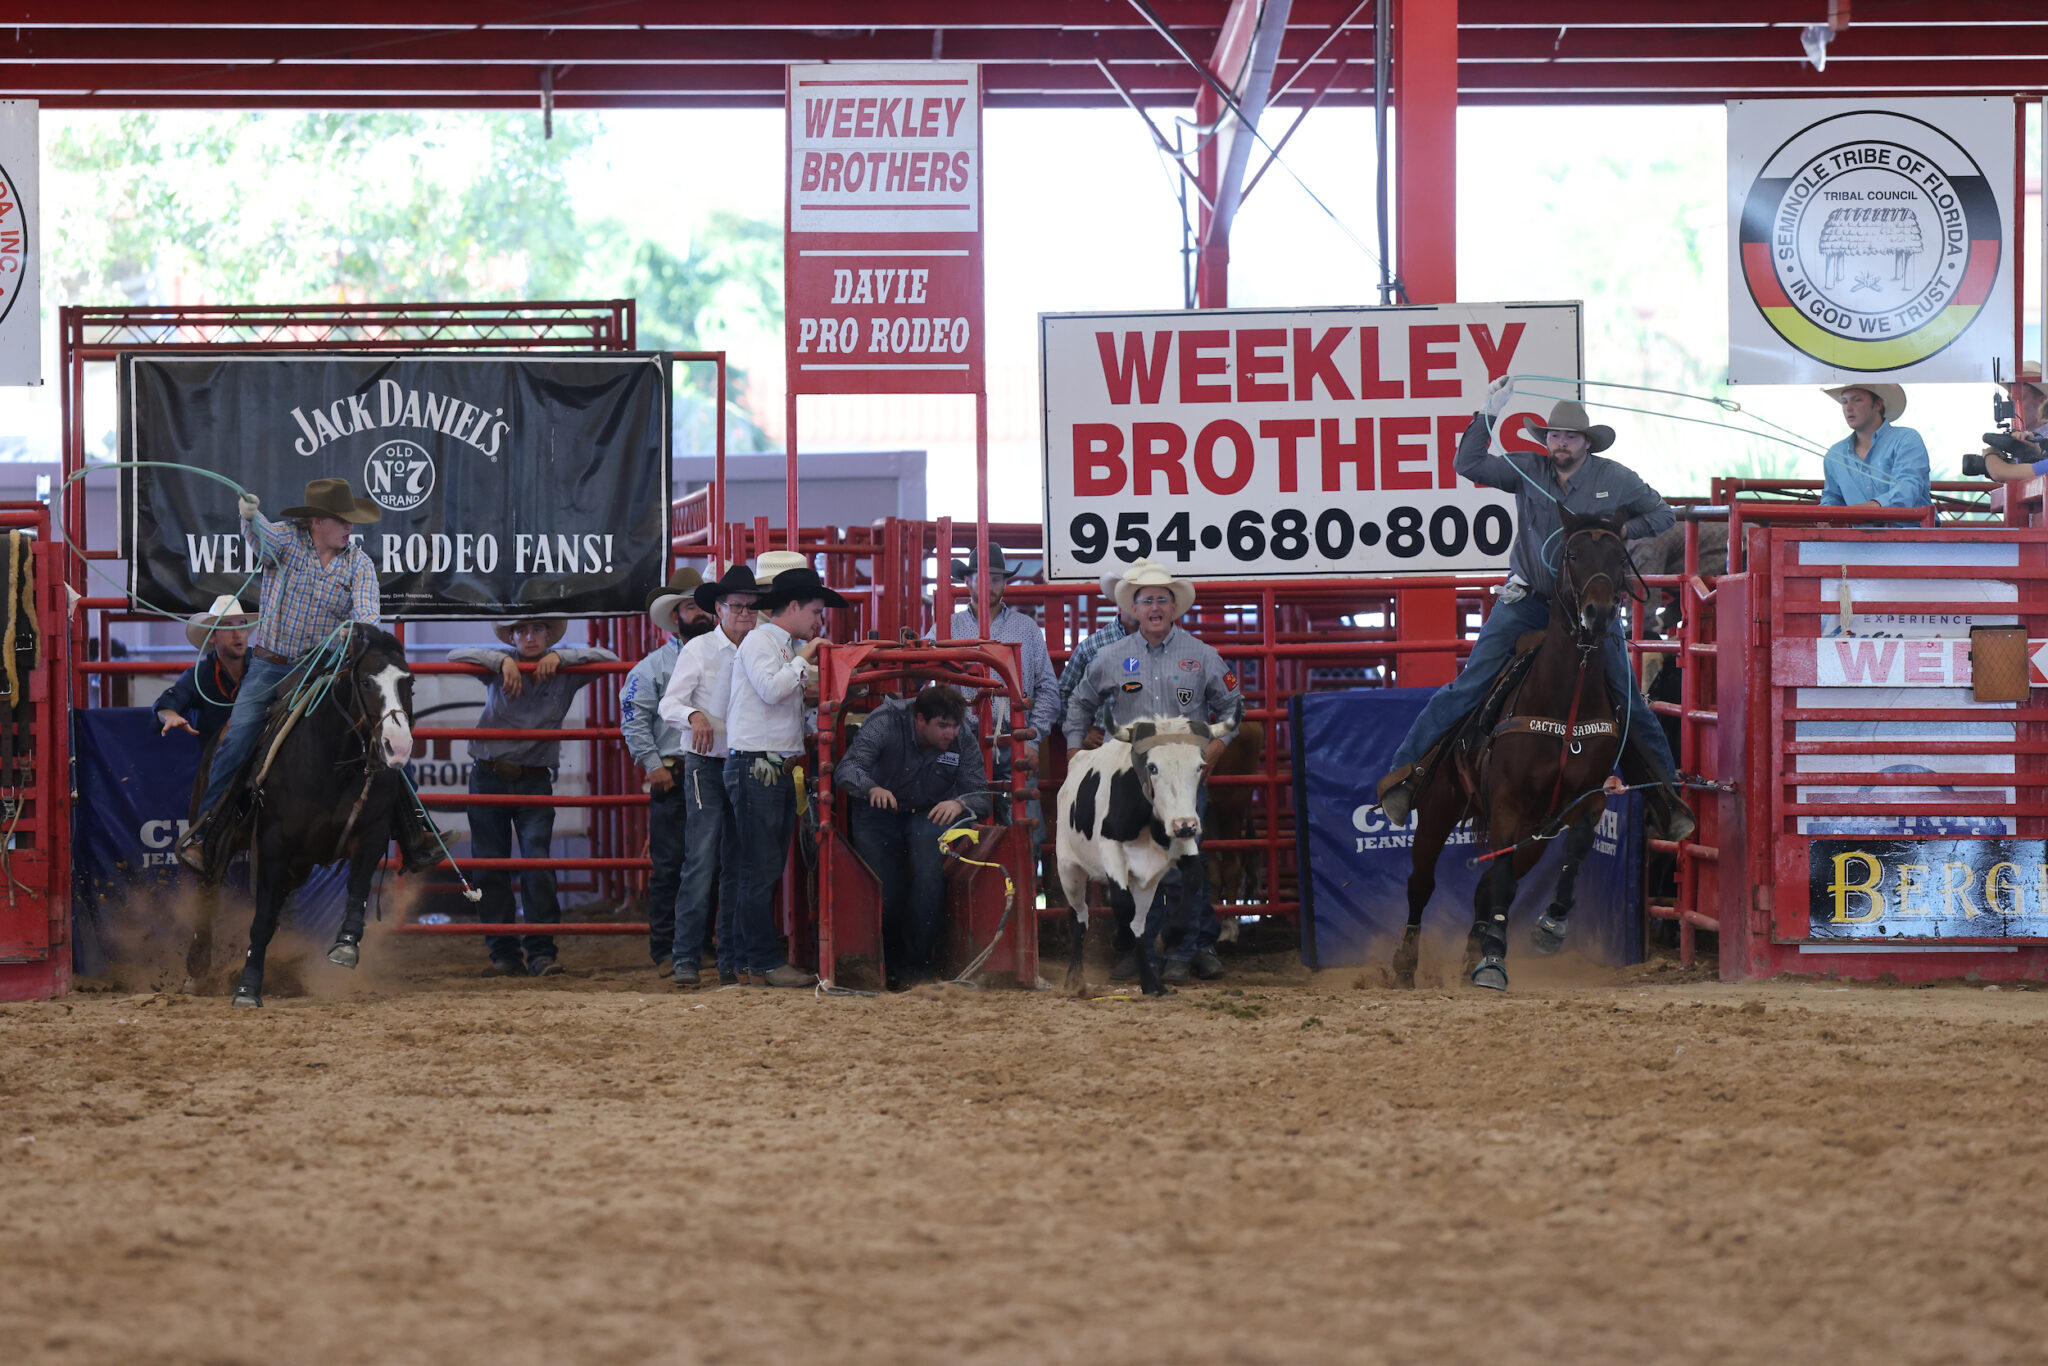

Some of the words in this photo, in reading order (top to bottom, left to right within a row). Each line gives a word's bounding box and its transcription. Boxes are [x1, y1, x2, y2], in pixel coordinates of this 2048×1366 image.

[805, 97, 966, 138] WEEKLEY
[800, 151, 969, 193] BROTHERS
[1778, 163, 1830, 260] SEMINOLE
[1829, 148, 1891, 173] TRIBE
[1896, 154, 1926, 176] OF
[1922, 172, 1963, 257] FLORIDA
[1824, 191, 1864, 201] TRIBAL
[1867, 190, 1918, 201] COUNCIL
[0, 230, 20, 274] INC
[830, 268, 929, 304] DAVIE
[1789, 278, 1812, 301] IN
[1809, 298, 1852, 330] GOD
[1858, 317, 1892, 334] WE
[1894, 279, 1952, 327] TRUST
[796, 316, 859, 353] PRO
[868, 316, 970, 353] RODEO
[1095, 322, 1527, 405] WEEKLEY
[290, 393, 376, 456] JACK
[378, 378, 510, 457] DANIEL'S
[386, 445, 413, 457] OLD
[381, 494, 420, 507] BRAND
[381, 533, 498, 574] RODEO
[514, 533, 614, 574] FANS!
[1863, 614, 1973, 625] EXPERIENCE
[1529, 720, 1567, 735] CACTUS
[142, 853, 179, 869] JEA
